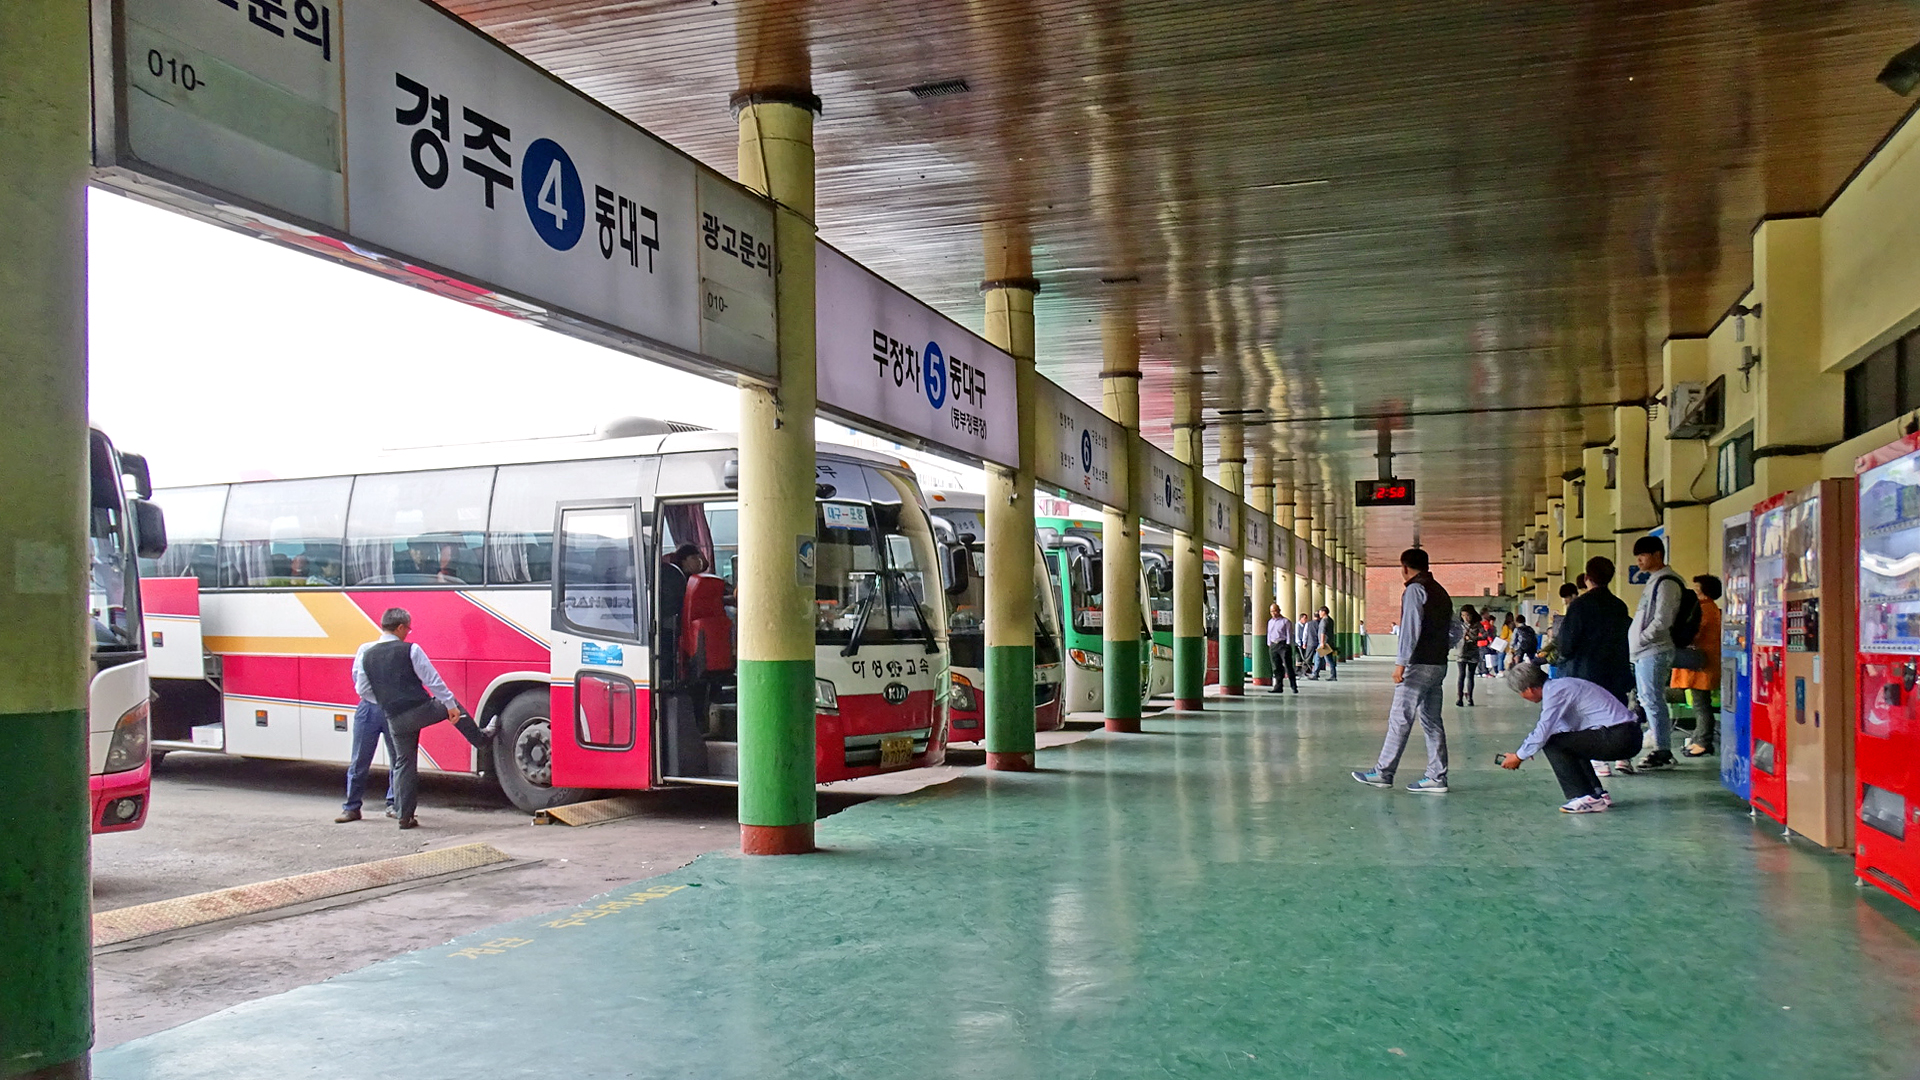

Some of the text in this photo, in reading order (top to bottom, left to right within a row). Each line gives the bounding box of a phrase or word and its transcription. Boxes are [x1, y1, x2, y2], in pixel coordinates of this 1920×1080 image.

[147, 49, 206, 91] 010-
[395, 72, 660, 274] 경주 4 동대구
[702, 211, 772, 278] 광고문의
[707, 291, 729, 312] 010-
[873, 328, 987, 410] 무정차 5 동대구
[950, 406, 988, 440] (동부정류장)
[827, 507, 841, 520] 대구
[888, 686, 908, 700] KIA
[447, 938, 534, 960] 계단
